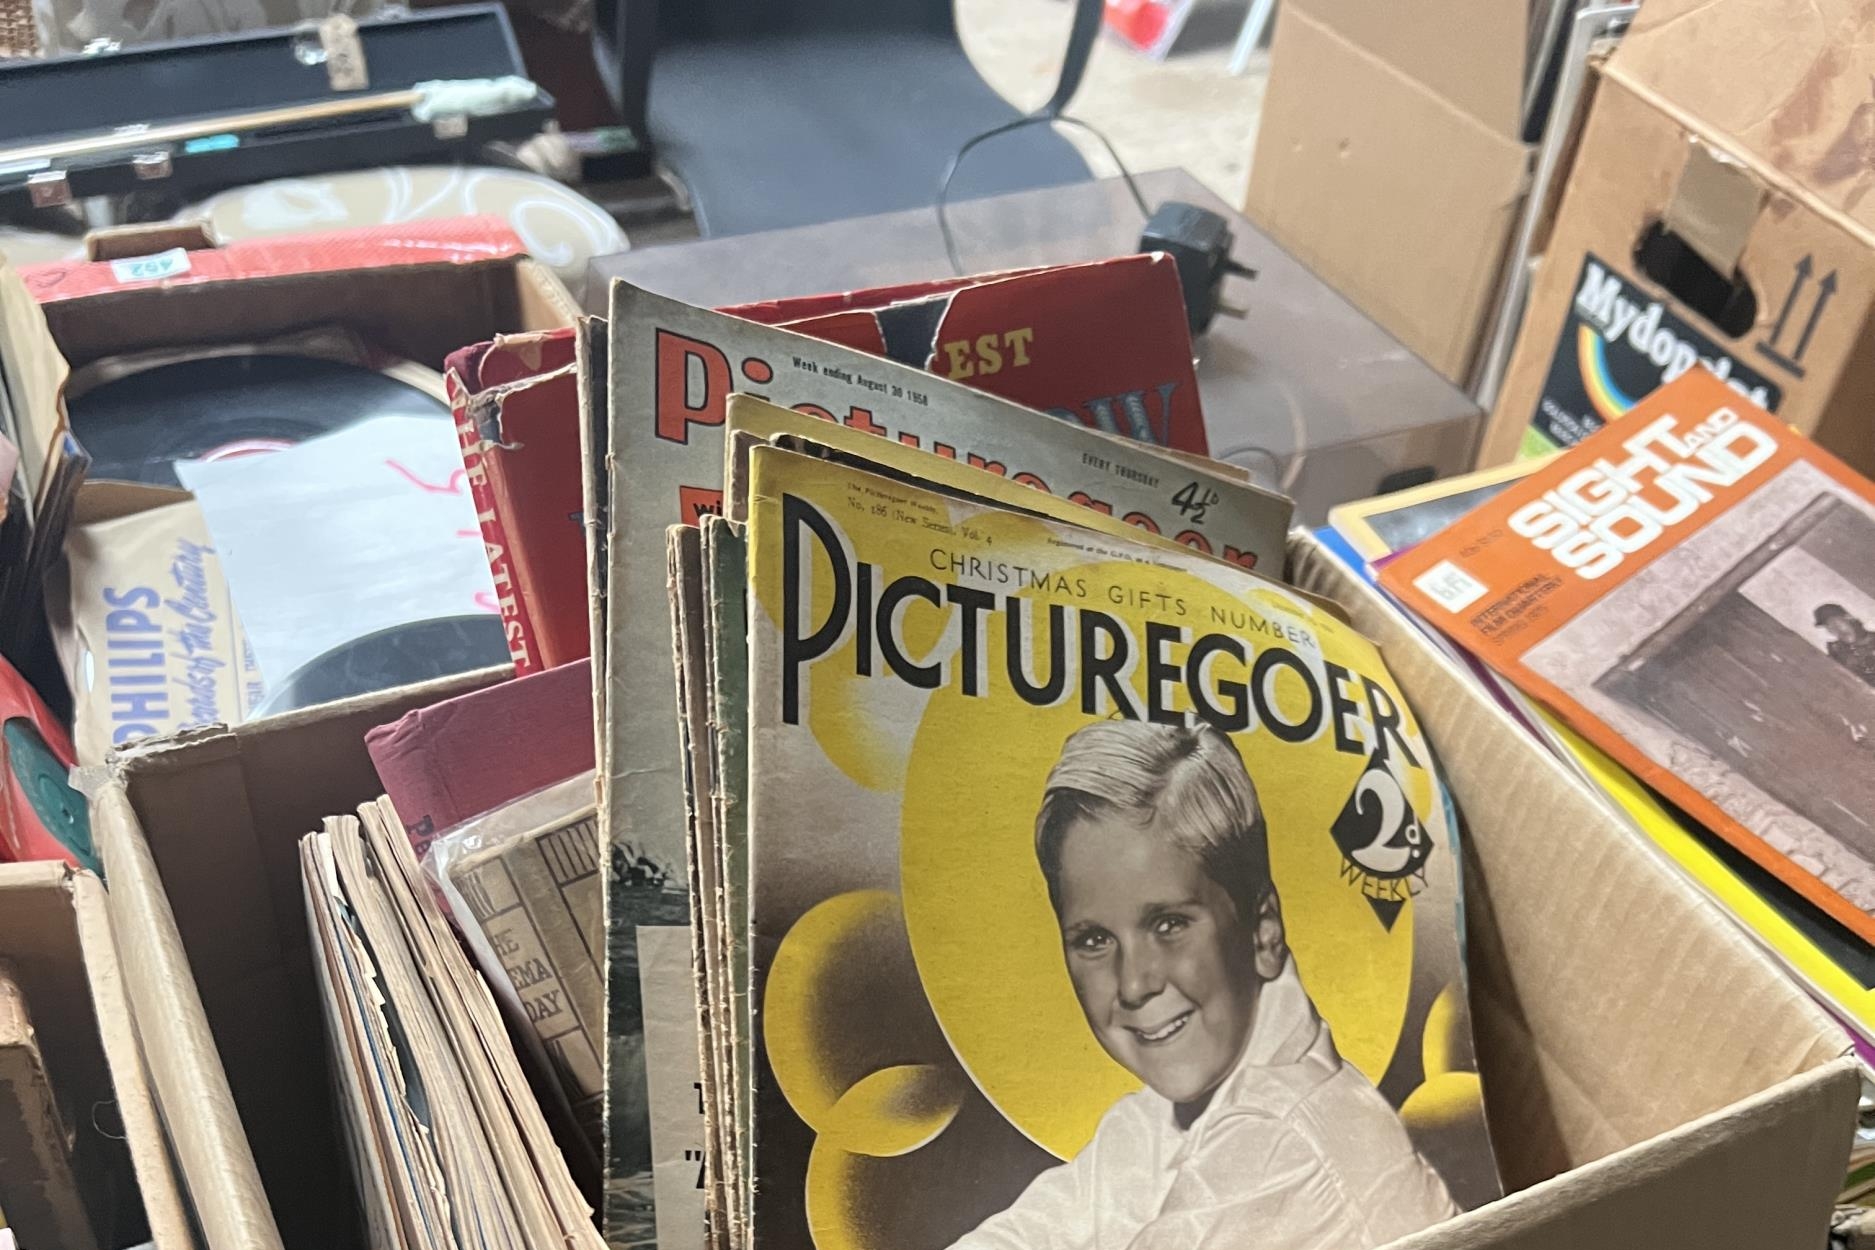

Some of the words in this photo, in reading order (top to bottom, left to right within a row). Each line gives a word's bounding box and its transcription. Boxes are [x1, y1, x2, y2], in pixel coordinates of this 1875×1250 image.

[792, 356, 818, 374] Week
[823, 365, 853, 384] ending
[857, 375, 888, 394] August
[1082, 452, 1110, 473] EVERY
[1114, 464, 1160, 489] THURSDAY
[1507, 413, 1688, 551] SIGHT
[1683, 406, 1739, 450] AND
[1550, 421, 1779, 580] SOUND
[782, 492, 1423, 769] PICTUREGOER
[930, 548, 1087, 598] CHRISTMAS
[1108, 585, 1188, 616] GIFTS
[1211, 606, 1317, 649] NUMBER
[103, 587, 170, 744] PHILIPS
[1340, 858, 1428, 901] WEEKLY
